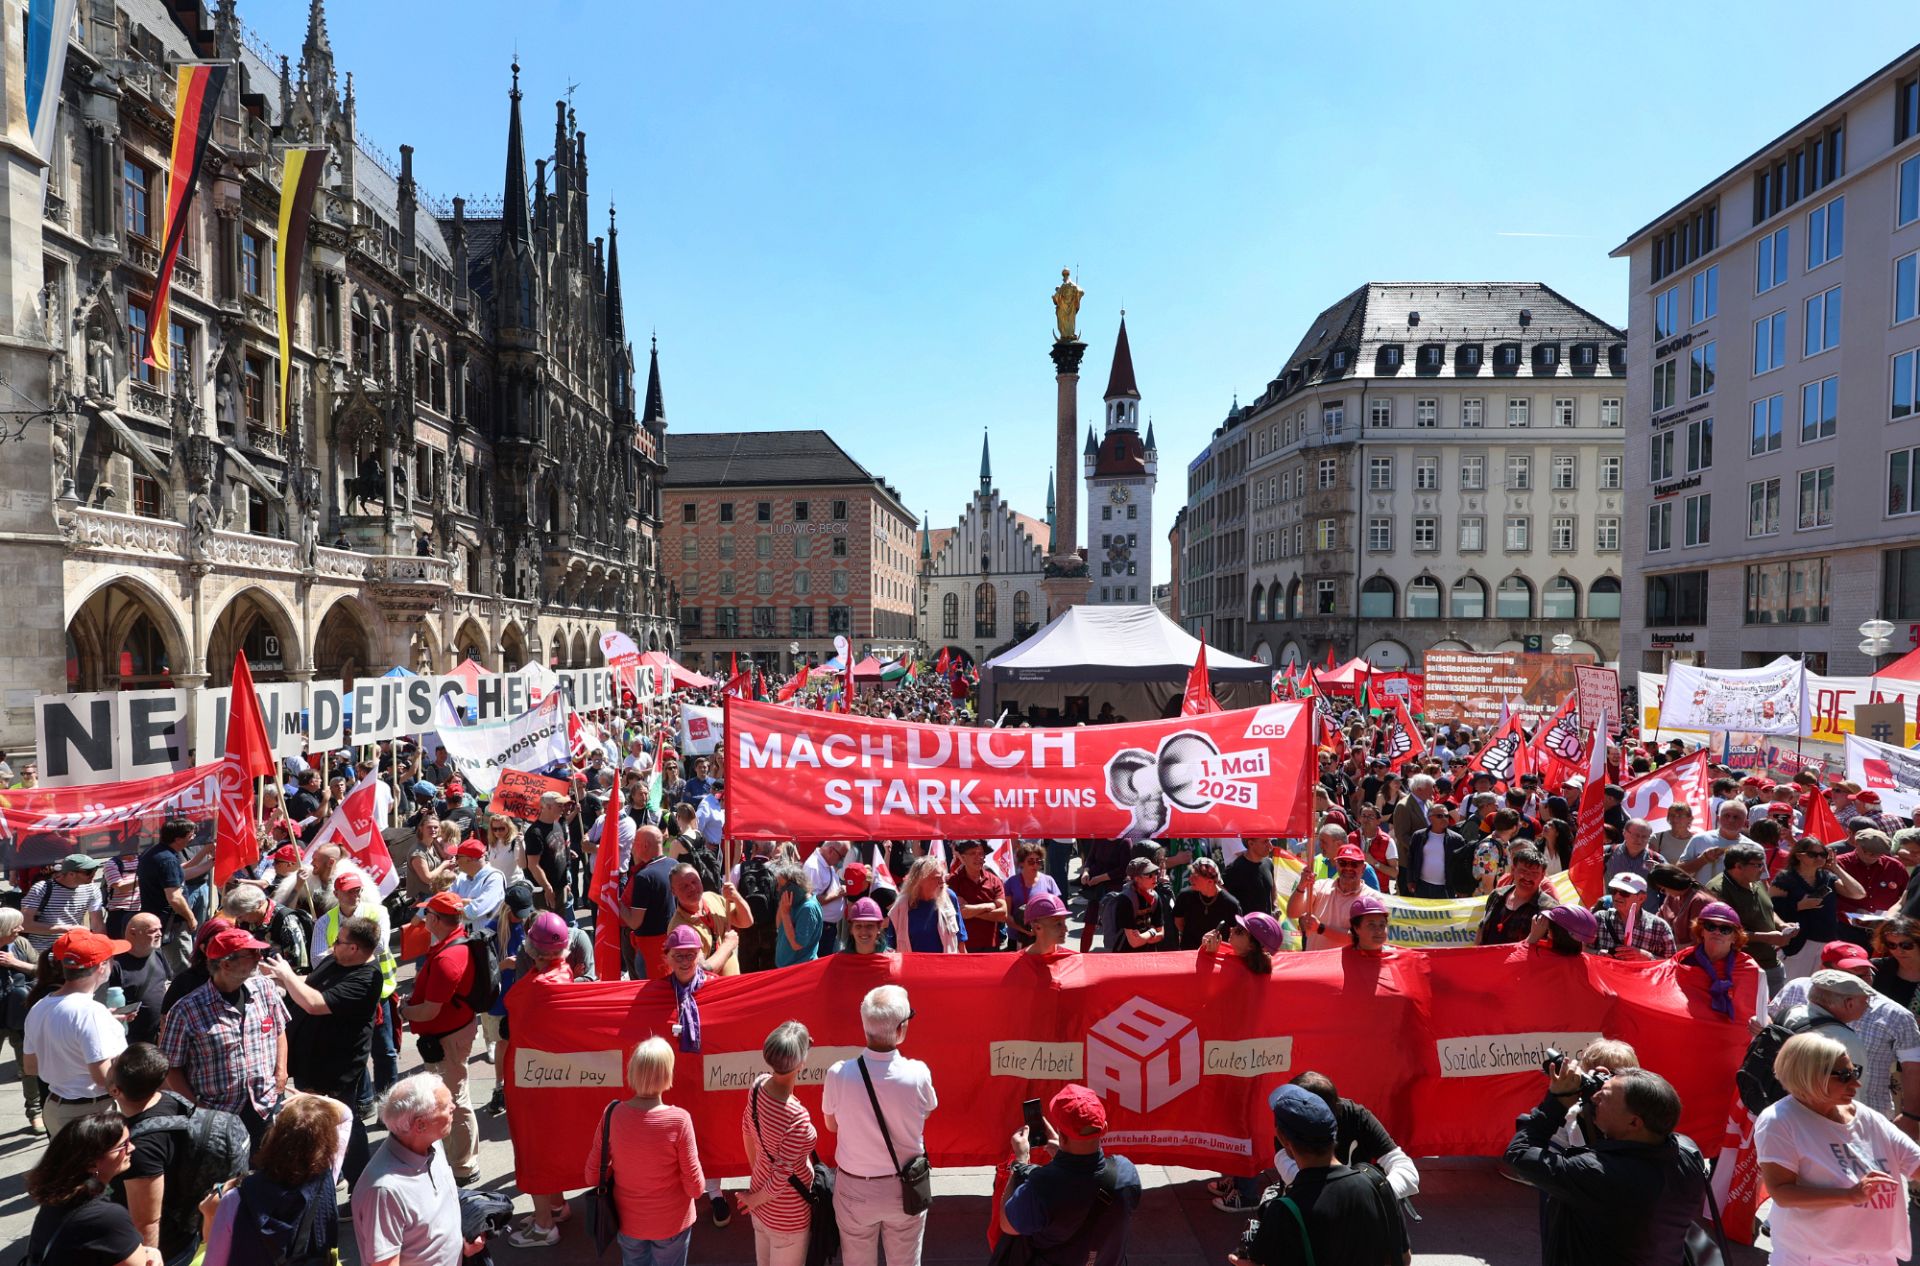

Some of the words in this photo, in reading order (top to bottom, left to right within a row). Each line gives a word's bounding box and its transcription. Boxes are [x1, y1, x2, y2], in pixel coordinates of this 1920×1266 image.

[1654, 475, 1701, 496] Hugendubel
[770, 523, 816, 535] LUDWIG
[819, 523, 848, 534] BECK
[1651, 633, 1694, 644] Hugendubel
[1251, 724, 1285, 736] DGB
[486, 722, 565, 769] Aerospace
[739, 732, 893, 769] MACH
[907, 729, 1076, 769] DICH
[1201, 760, 1217, 777] 1.
[1221, 753, 1265, 776] Mai
[502, 772, 548, 789] GESUNDE
[1196, 780, 1252, 803] 2025
[824, 778, 982, 816] STARK
[994, 787, 1042, 808] MIT
[1045, 787, 1097, 808] UNS
[1030, 1046, 1073, 1072] Arbeit
[1207, 1047, 1248, 1071] Gutes
[1251, 1047, 1285, 1069] Leben
[1444, 1045, 1486, 1072] Soziale
[1489, 1041, 1546, 1068] Sicherheit
[523, 1059, 571, 1083] Equal
[580, 1069, 607, 1085] pay
[1100, 1134, 1149, 1144] werkschaft
